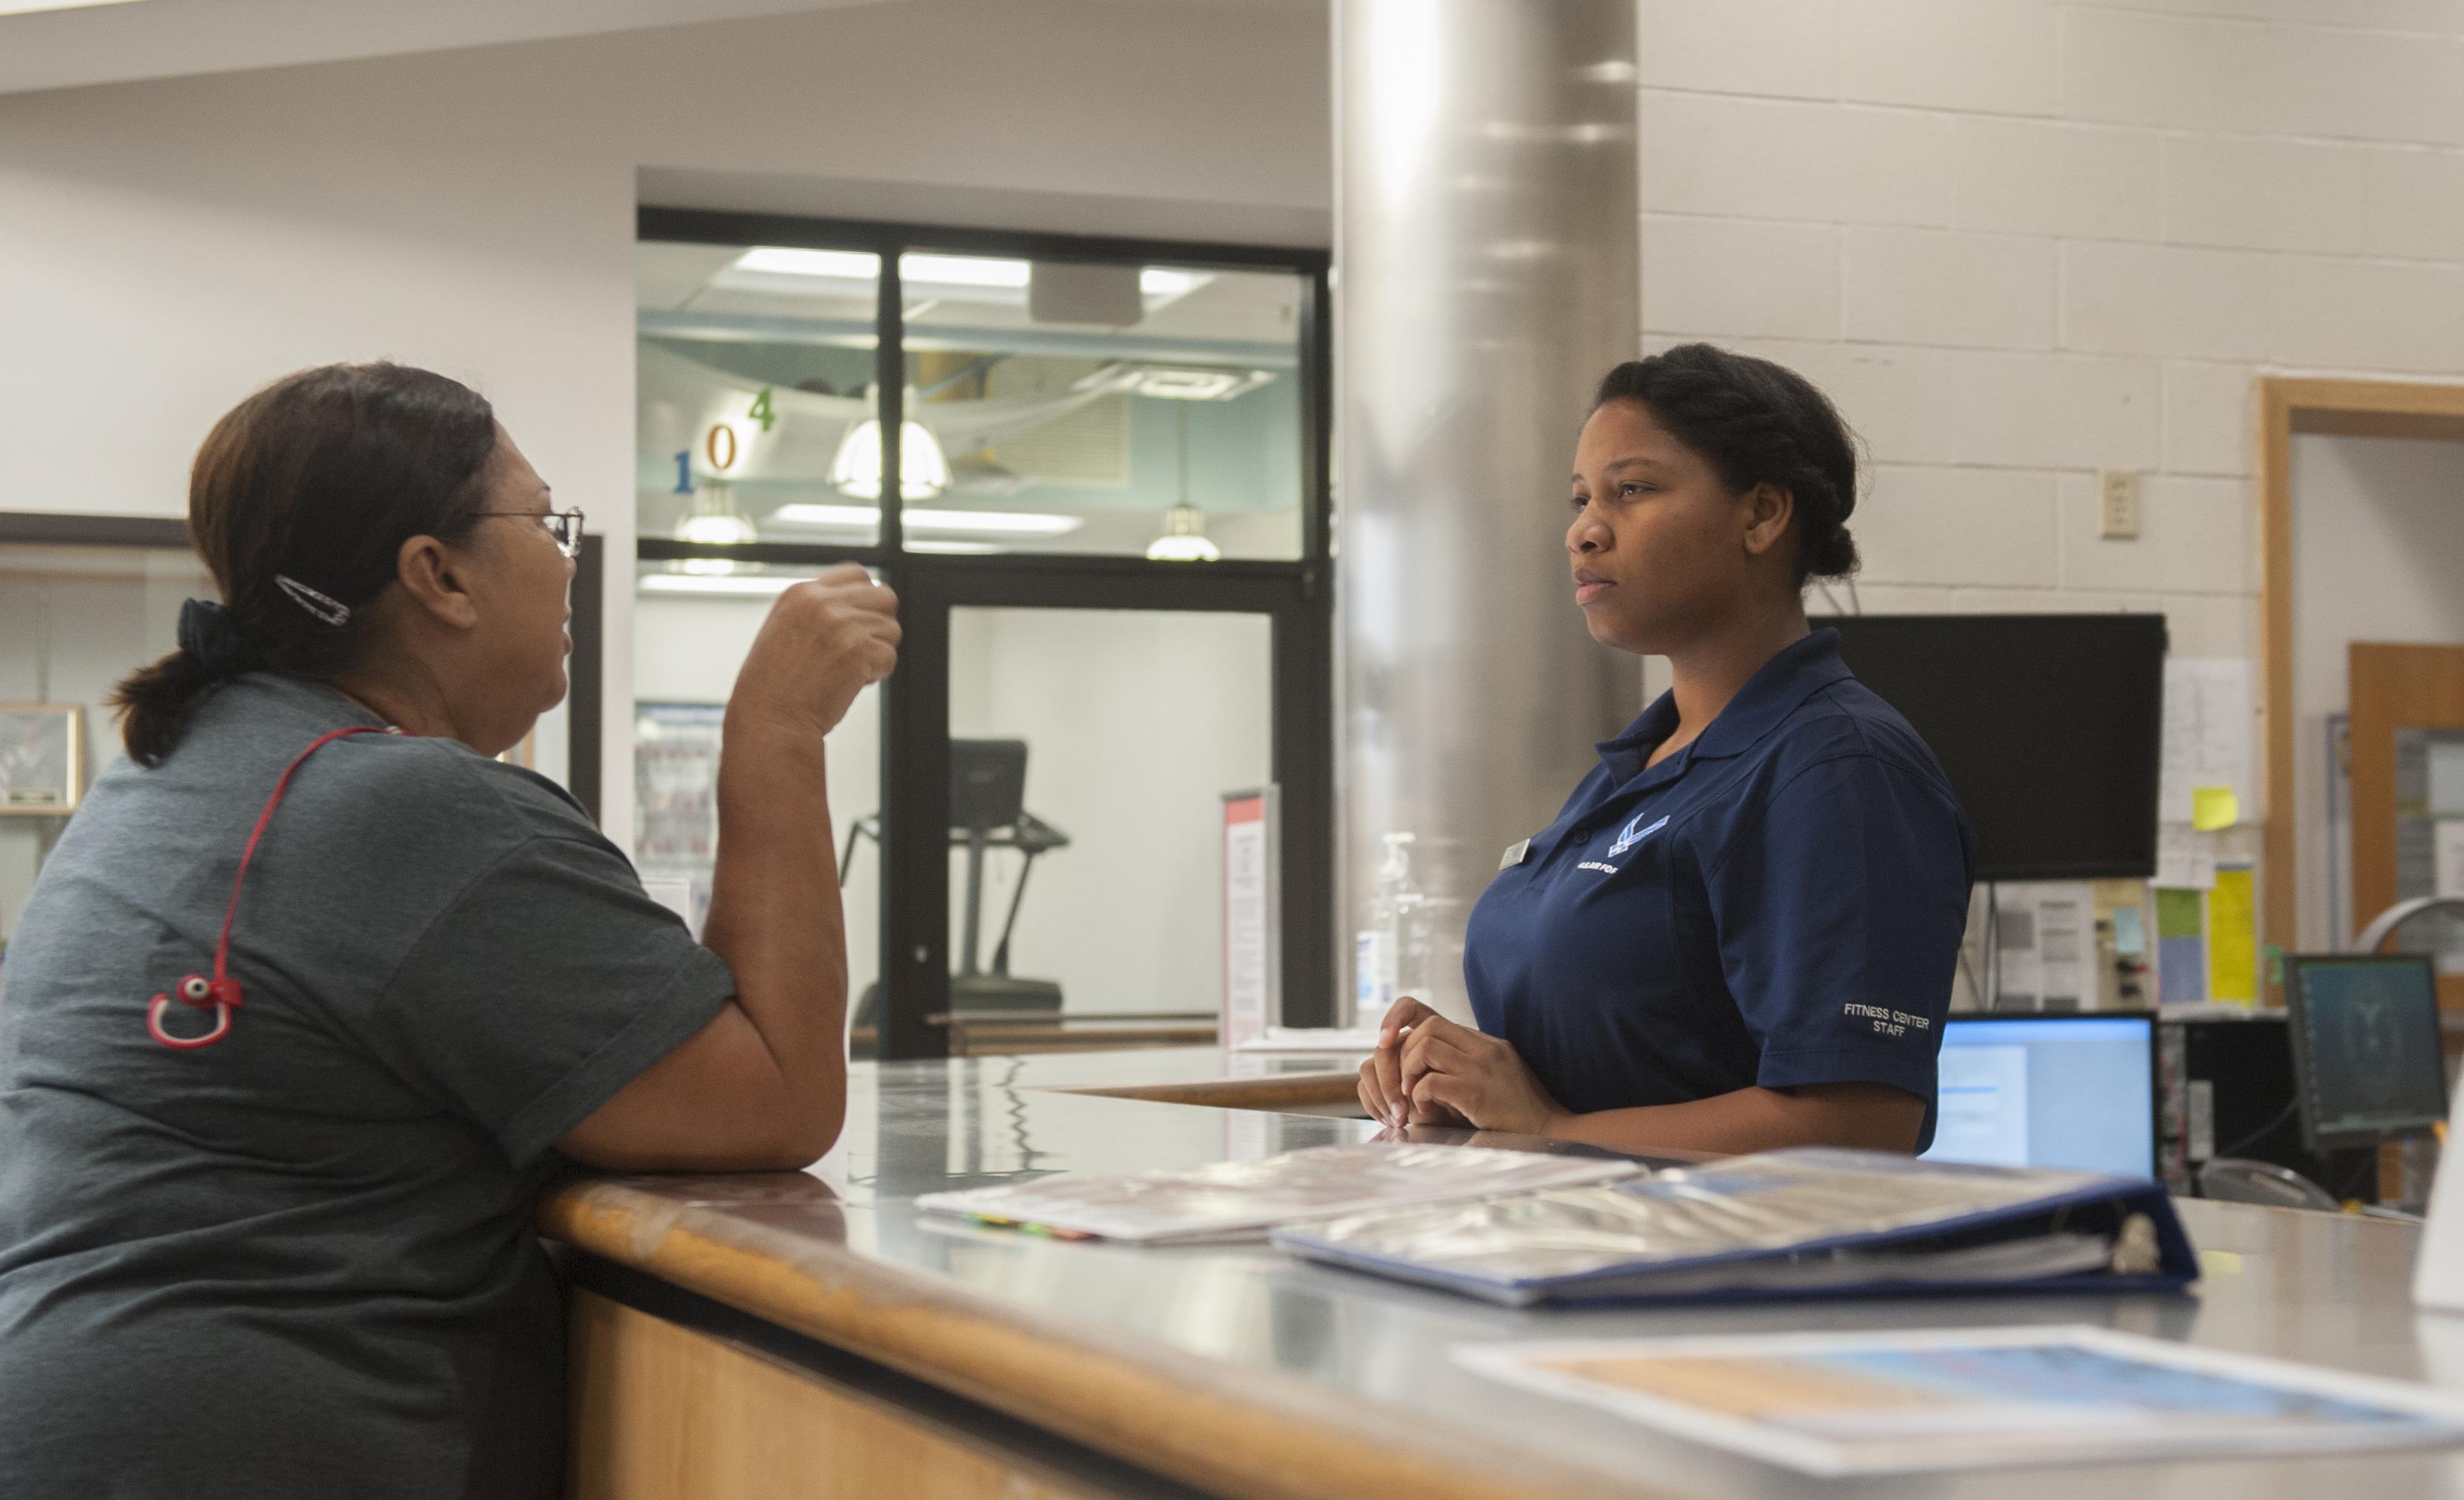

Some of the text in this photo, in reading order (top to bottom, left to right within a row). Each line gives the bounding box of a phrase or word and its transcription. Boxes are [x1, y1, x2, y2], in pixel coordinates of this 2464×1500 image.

[1844, 1003, 1929, 1029] FITNESS CENTER
[1874, 1020, 1905, 1037] STAFF
